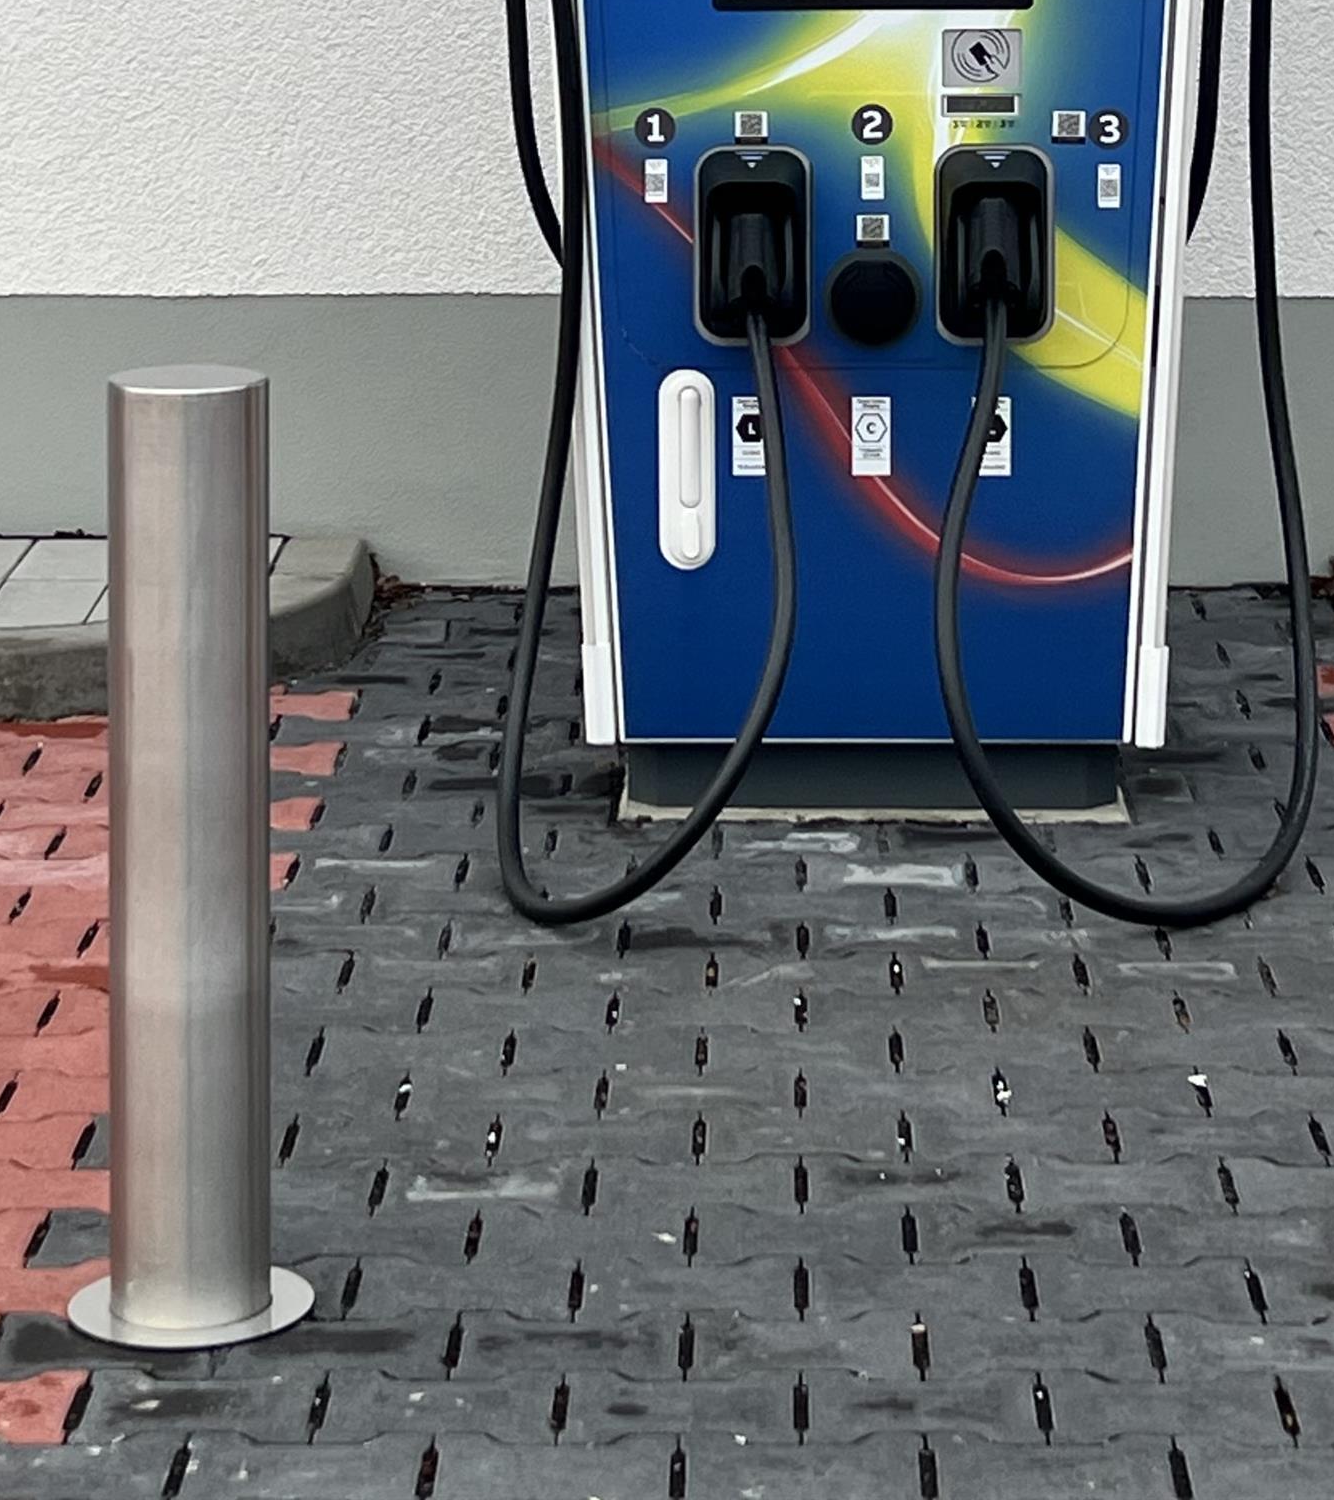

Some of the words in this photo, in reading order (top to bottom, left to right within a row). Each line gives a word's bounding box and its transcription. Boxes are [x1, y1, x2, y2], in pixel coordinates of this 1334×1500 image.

[646, 113, 665, 142] 1
[861, 111, 883, 139] 2
[1099, 114, 1121, 144] 3
